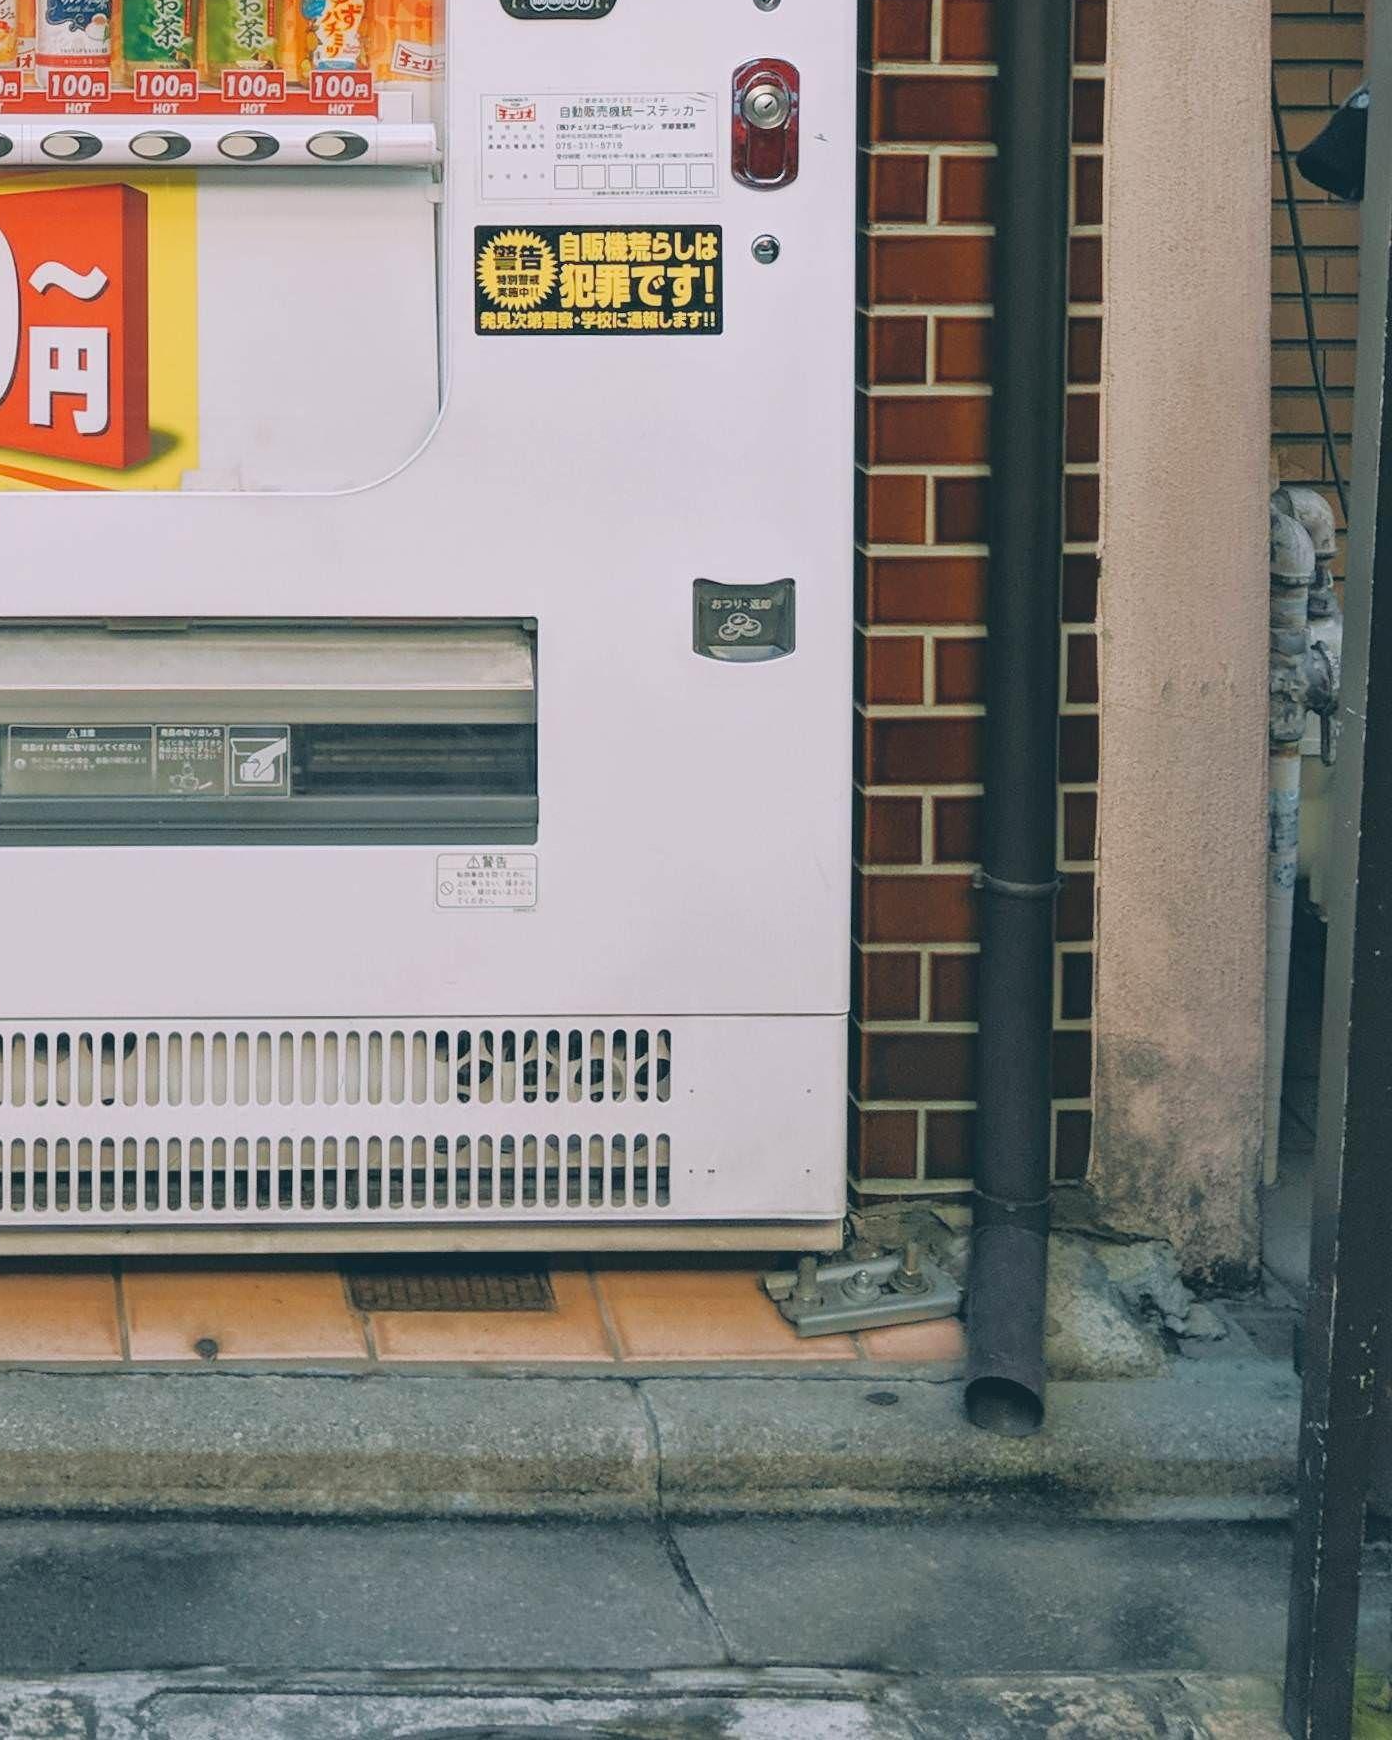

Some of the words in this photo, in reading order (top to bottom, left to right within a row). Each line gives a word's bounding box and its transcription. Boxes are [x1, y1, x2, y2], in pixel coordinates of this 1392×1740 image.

[51, 75, 106, 97] 100円
[139, 75, 195, 97] 100円
[226, 75, 281, 97] 100円
[314, 75, 369, 98] 100円
[65, 102, 92, 113] HOT
[153, 102, 179, 114] HOT
[240, 103, 267, 114] HOT
[328, 103, 355, 115] HOT
[498, 108, 533, 120] チェリオ
[559, 105, 707, 119] 自動販売機統一ステッカー
[559, 231, 718, 262] 自販機荒らしは
[493, 244, 543, 271] 警告
[496, 274, 540, 286] 特別警戒
[559, 263, 714, 309] 犯罪です!
[482, 854, 506, 868] 警告
